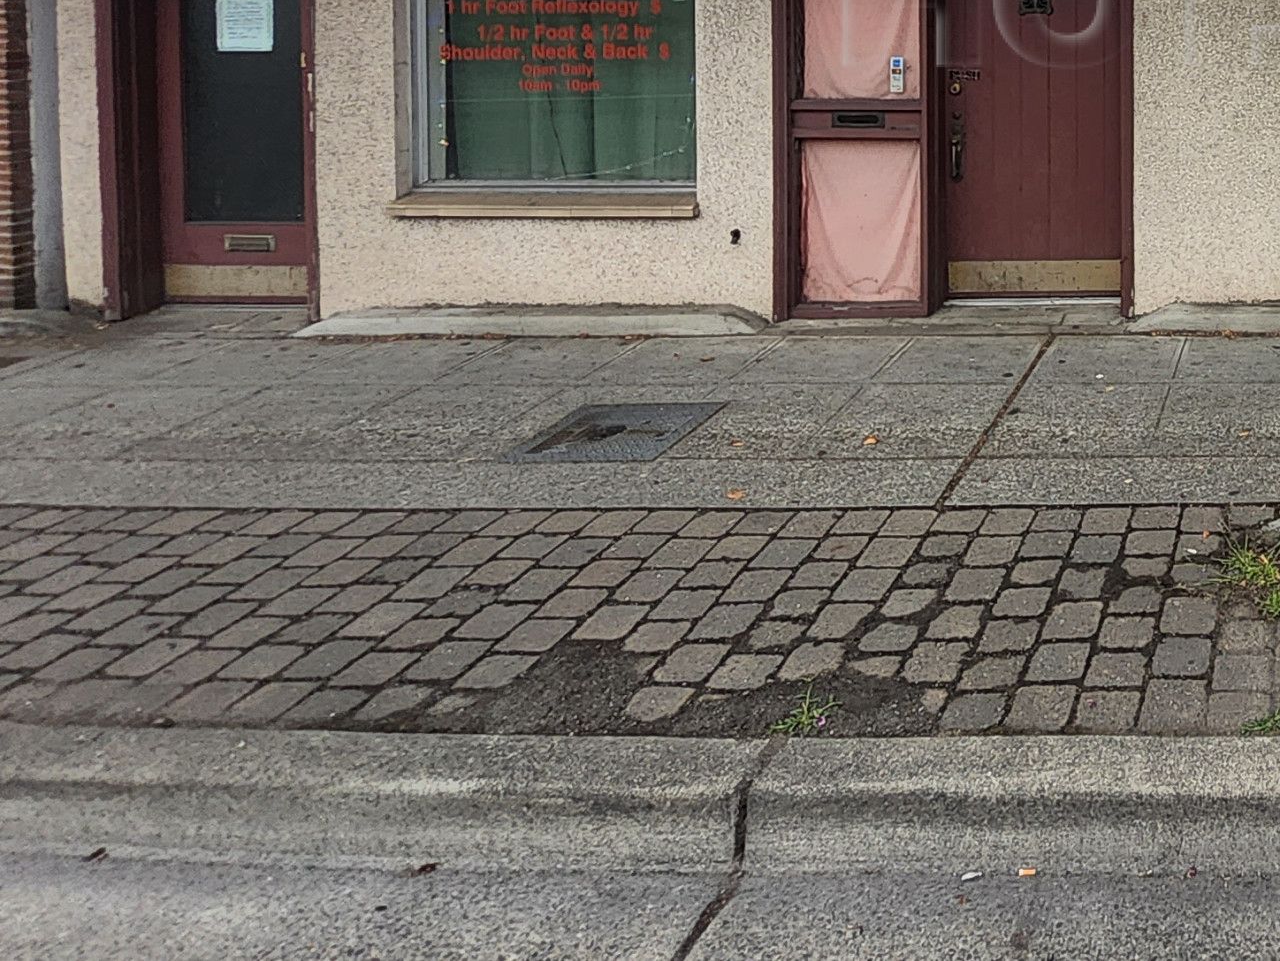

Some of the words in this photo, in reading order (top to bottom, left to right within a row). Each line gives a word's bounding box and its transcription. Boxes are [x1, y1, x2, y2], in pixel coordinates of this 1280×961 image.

[477, 25, 504, 41] 1/2
[510, 25, 530, 40] hr
[534, 25, 576, 40] Foot
[581, 24, 594, 40] &
[602, 25, 629, 40] 1/2
[633, 24, 653, 39] hr
[439, 44, 526, 62] Shoulder,
[532, 45, 578, 60] Neck
[583, 44, 597, 60] &
[602, 45, 649, 59] Back
[522, 64, 556, 76] Open
[560, 63, 594, 76] Daily
[519, 80, 552, 91] 10am
[566, 79, 601, 93] 10pm
